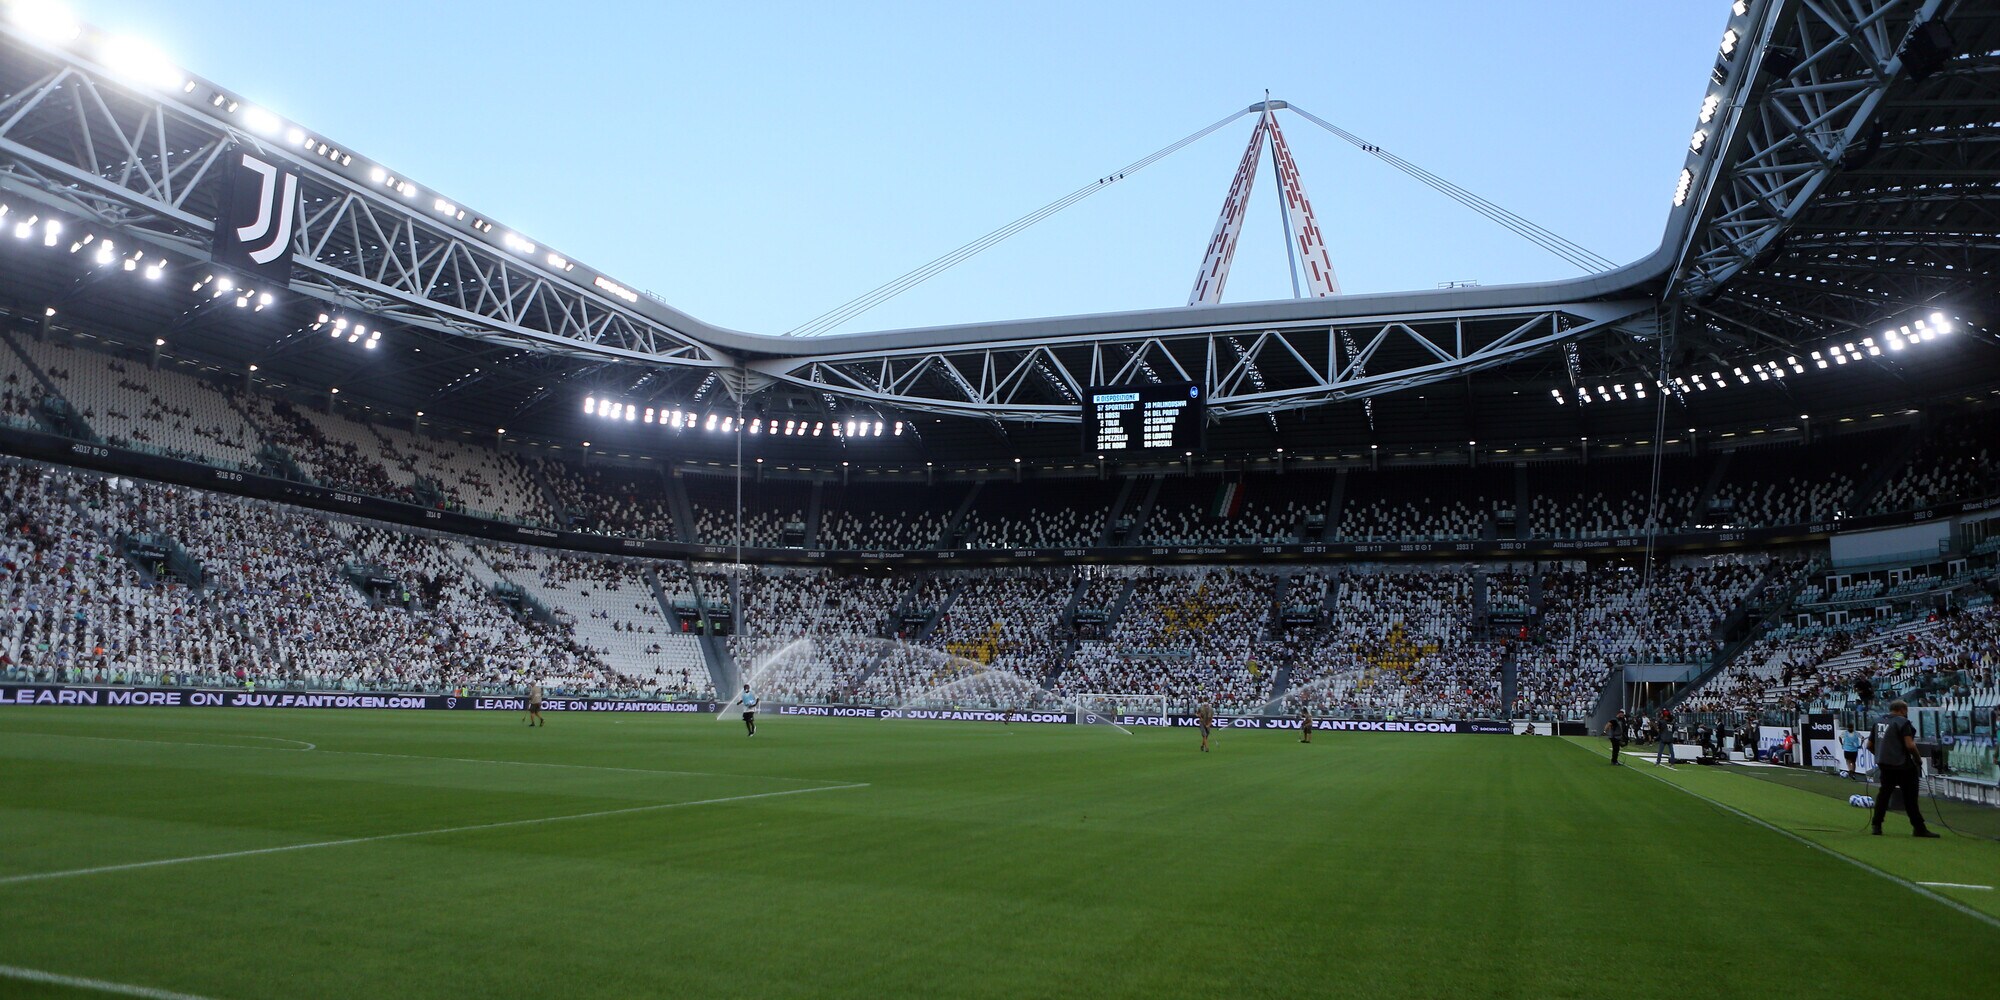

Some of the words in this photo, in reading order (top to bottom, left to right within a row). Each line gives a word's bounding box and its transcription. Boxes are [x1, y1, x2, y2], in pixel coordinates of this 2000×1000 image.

[75, 444, 91, 454] 2017
[0, 689, 98, 704] LEARN
[108, 691, 181, 705] MORE
[190, 692, 223, 706] ON
[232, 694, 426, 709] JUV.FANTOKEN.COM
[475, 699, 524, 710] LEARN
[529, 700, 566, 710] ORE
[570, 701, 588, 710] ON
[591, 701, 698, 712] JUV.FANTOKEN.COM
[780, 706, 828, 716] LEARN
[833, 707, 875, 717] MORE
[880, 709, 902, 718] ON
[1114, 716, 1172, 726] LEARN
[1234, 718, 1260, 728] ON
[1265, 719, 1456, 733] JUVFANTOKEN.COM
[1812, 722, 1833, 732] Jeep
[1877, 722, 1889, 732] TV
